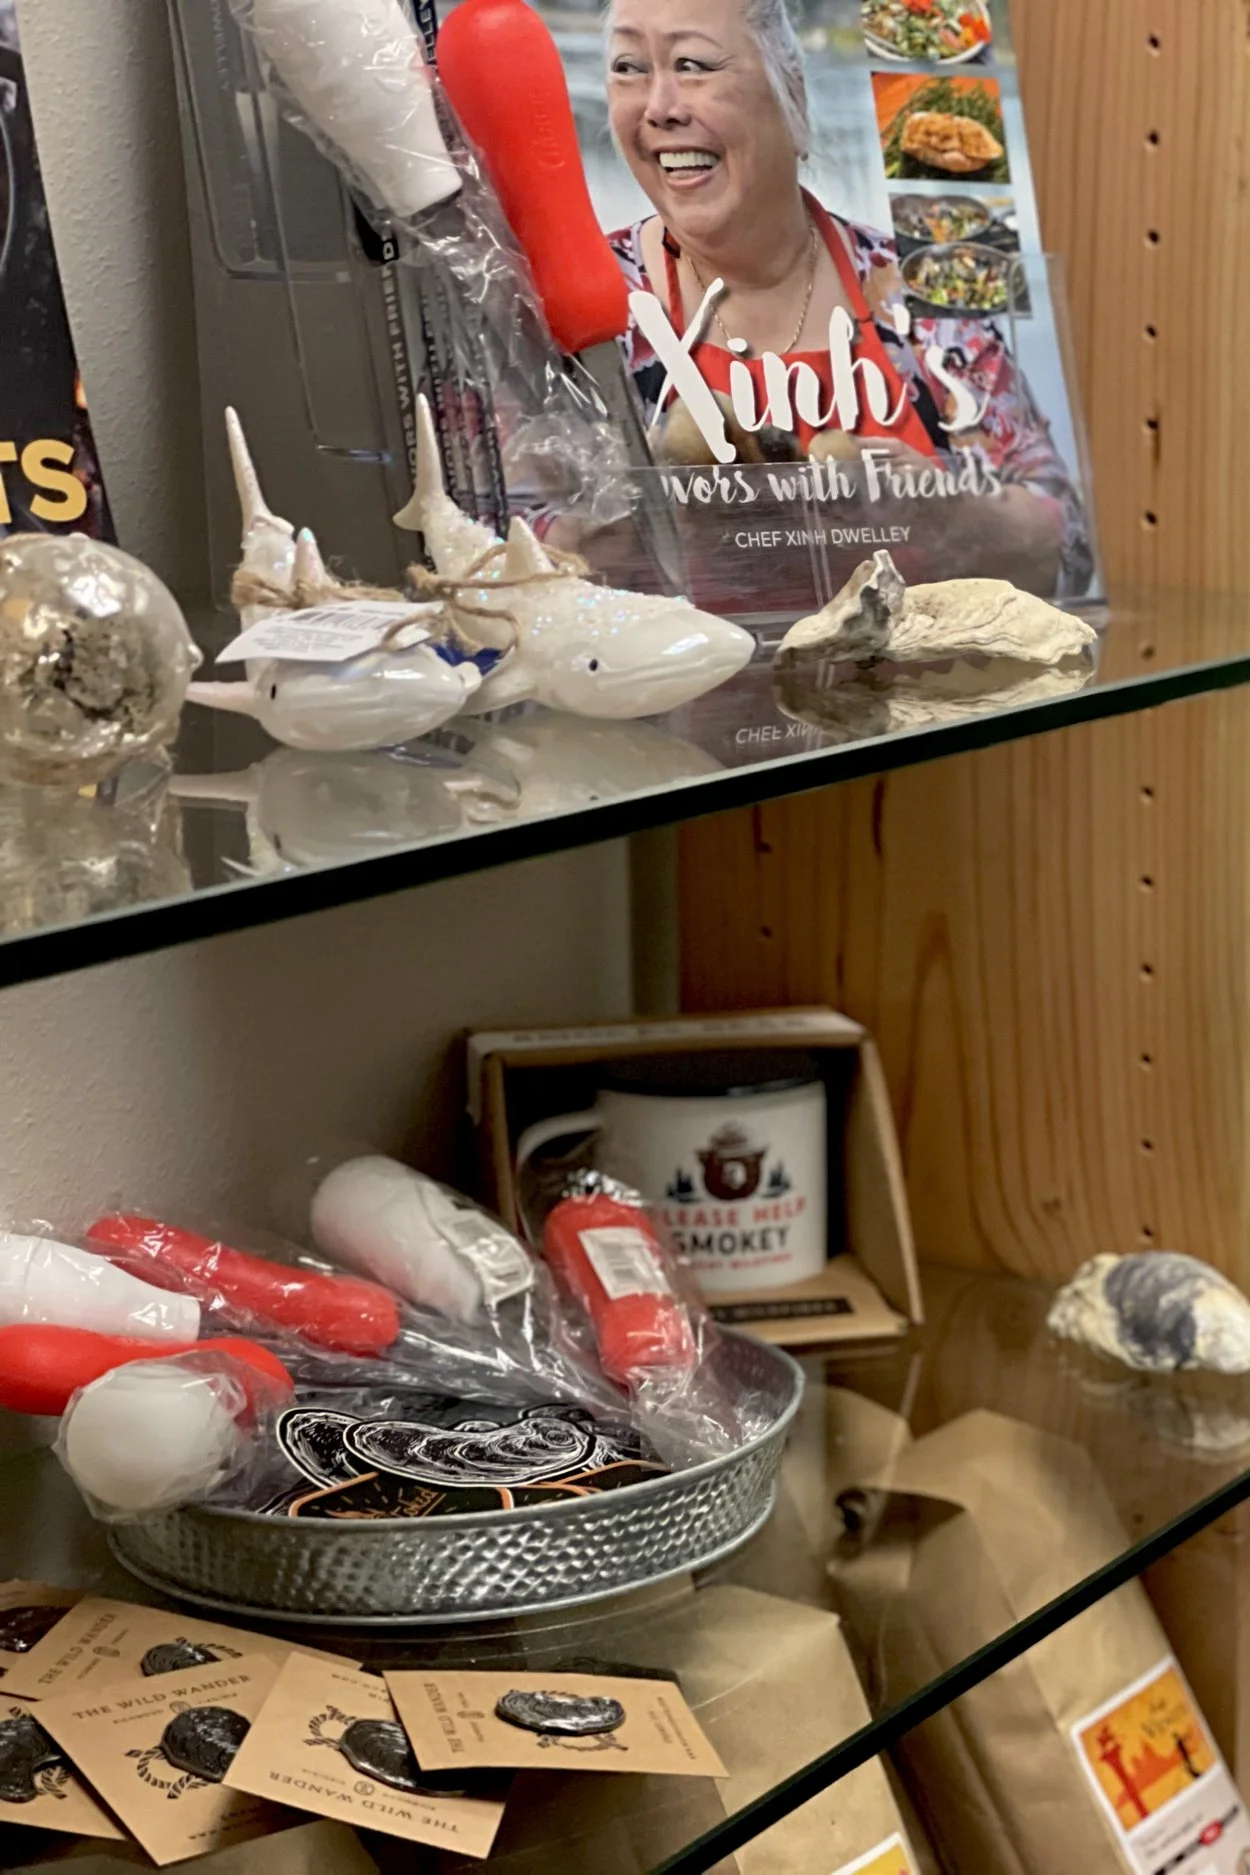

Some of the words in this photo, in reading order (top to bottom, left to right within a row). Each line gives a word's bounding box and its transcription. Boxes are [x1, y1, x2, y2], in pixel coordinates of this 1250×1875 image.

[628, 278, 991, 464] Xinh's
[661, 465, 760, 504] vors
[767, 453, 857, 502] with
[860, 446, 1003, 502] Friends
[735, 531, 782, 549] CHEF
[786, 529, 826, 547] XINH
[831, 526, 911, 546] DWELLEY
[663, 1207, 740, 1228] LEASE
[754, 1196, 807, 1222] HELP
[672, 1226, 790, 1257] SMOKEY
[72, 1704, 113, 1720] THE
[117, 1693, 167, 1710] WILD
[172, 1674, 251, 1698] WANDER
[269, 1771, 353, 1803] WANDER
[362, 1800, 412, 1820] WILD
[421, 1816, 459, 1833] THE
